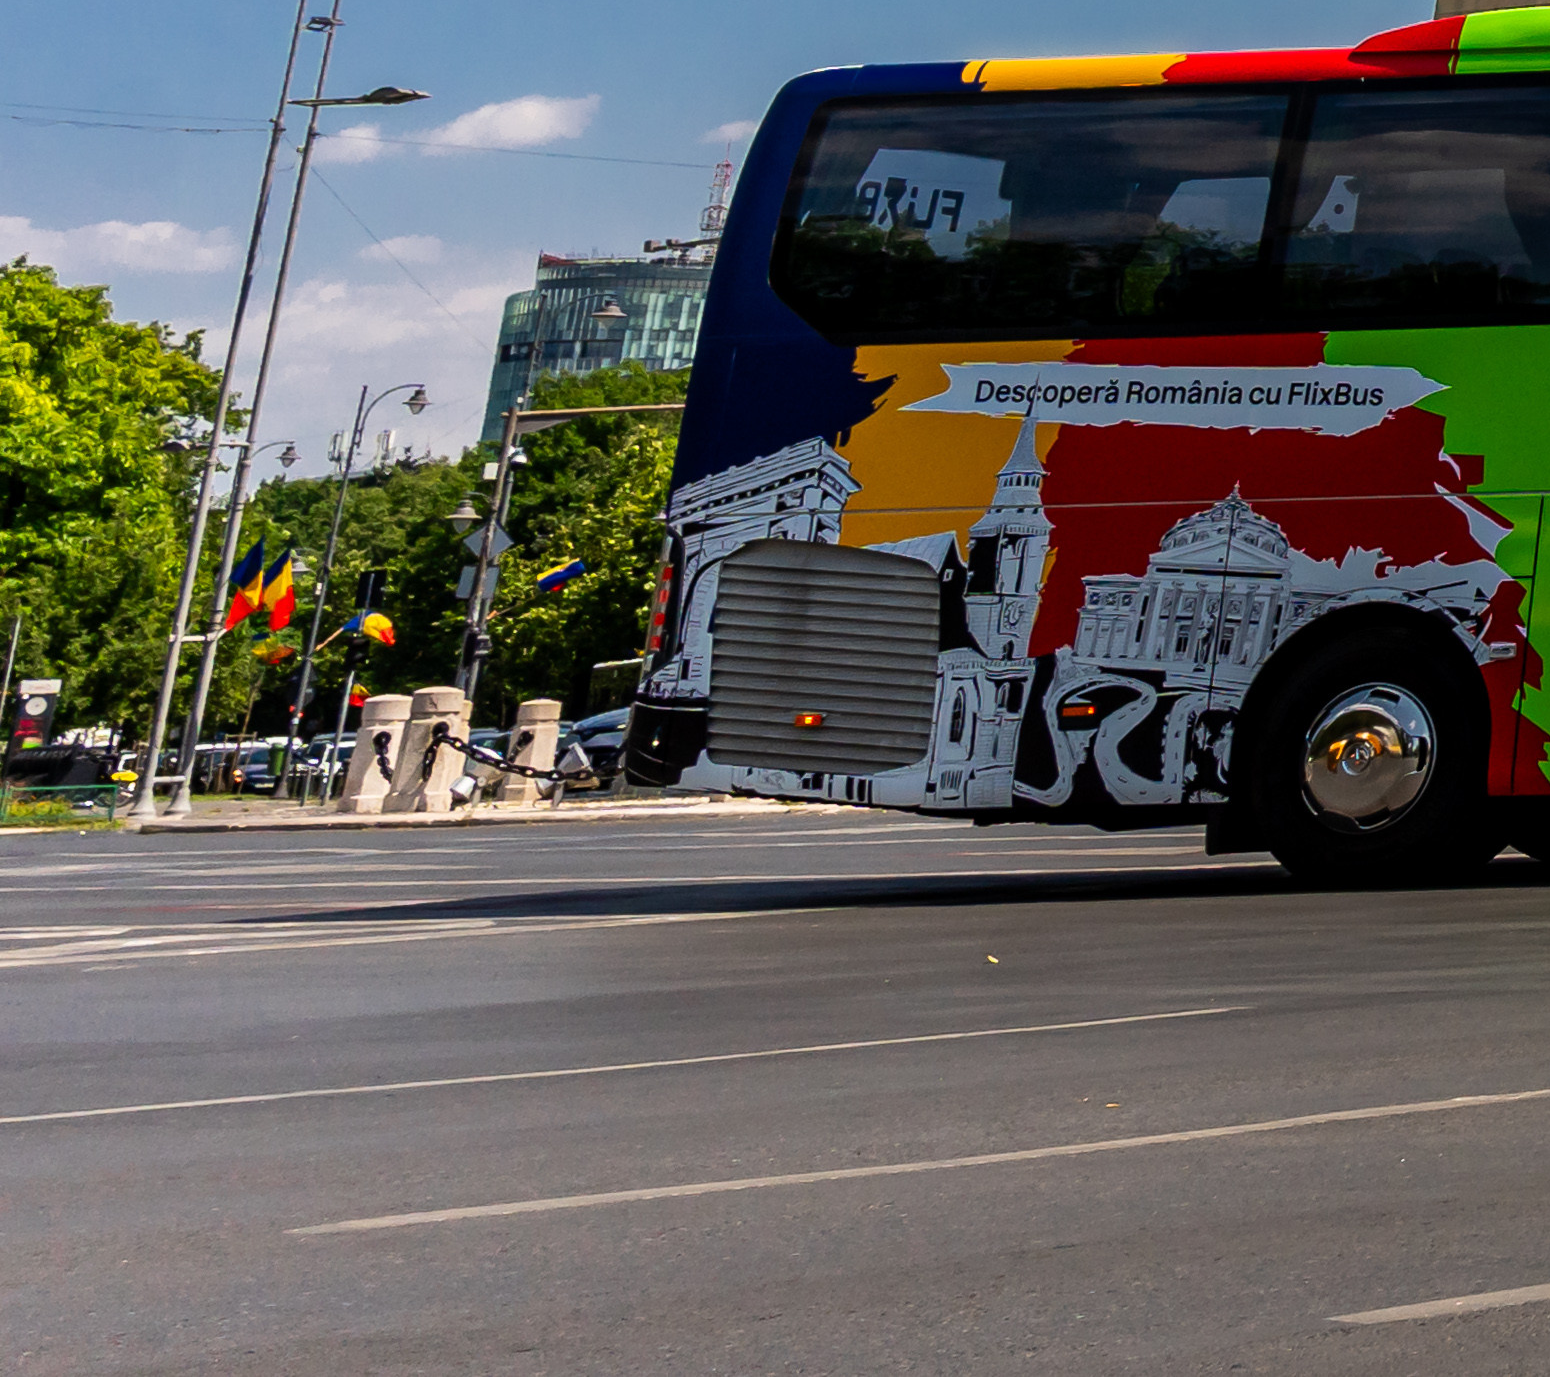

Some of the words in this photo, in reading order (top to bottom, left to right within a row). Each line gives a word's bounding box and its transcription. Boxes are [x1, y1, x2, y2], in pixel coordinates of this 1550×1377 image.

[974, 378, 1120, 409] Descoperă
[1126, 379, 1243, 405] România
[1248, 385, 1281, 405] cu
[1287, 382, 1385, 407] FlixBus
